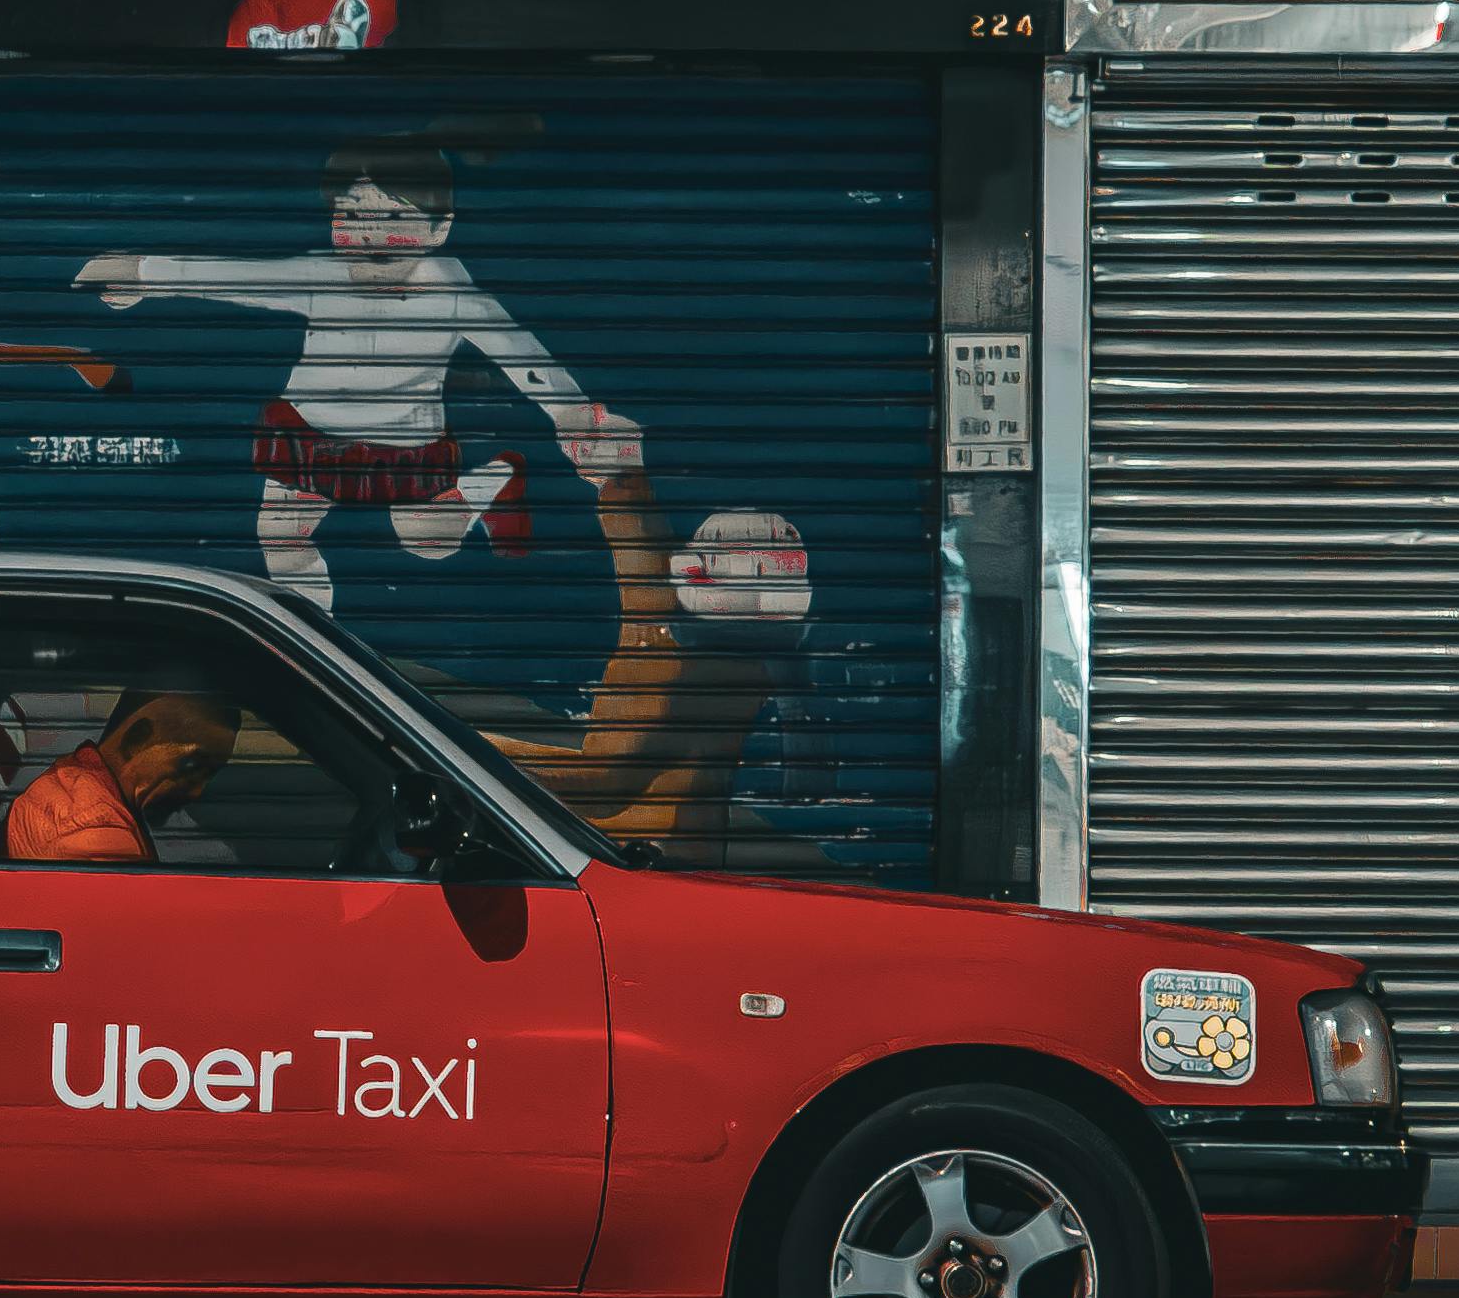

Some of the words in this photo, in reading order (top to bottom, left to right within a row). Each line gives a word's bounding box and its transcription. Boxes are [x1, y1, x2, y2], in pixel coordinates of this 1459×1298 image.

[968, 13, 1034, 39] 224
[51, 1022, 293, 1113] Uber
[313, 1029, 479, 1120] Taxi
